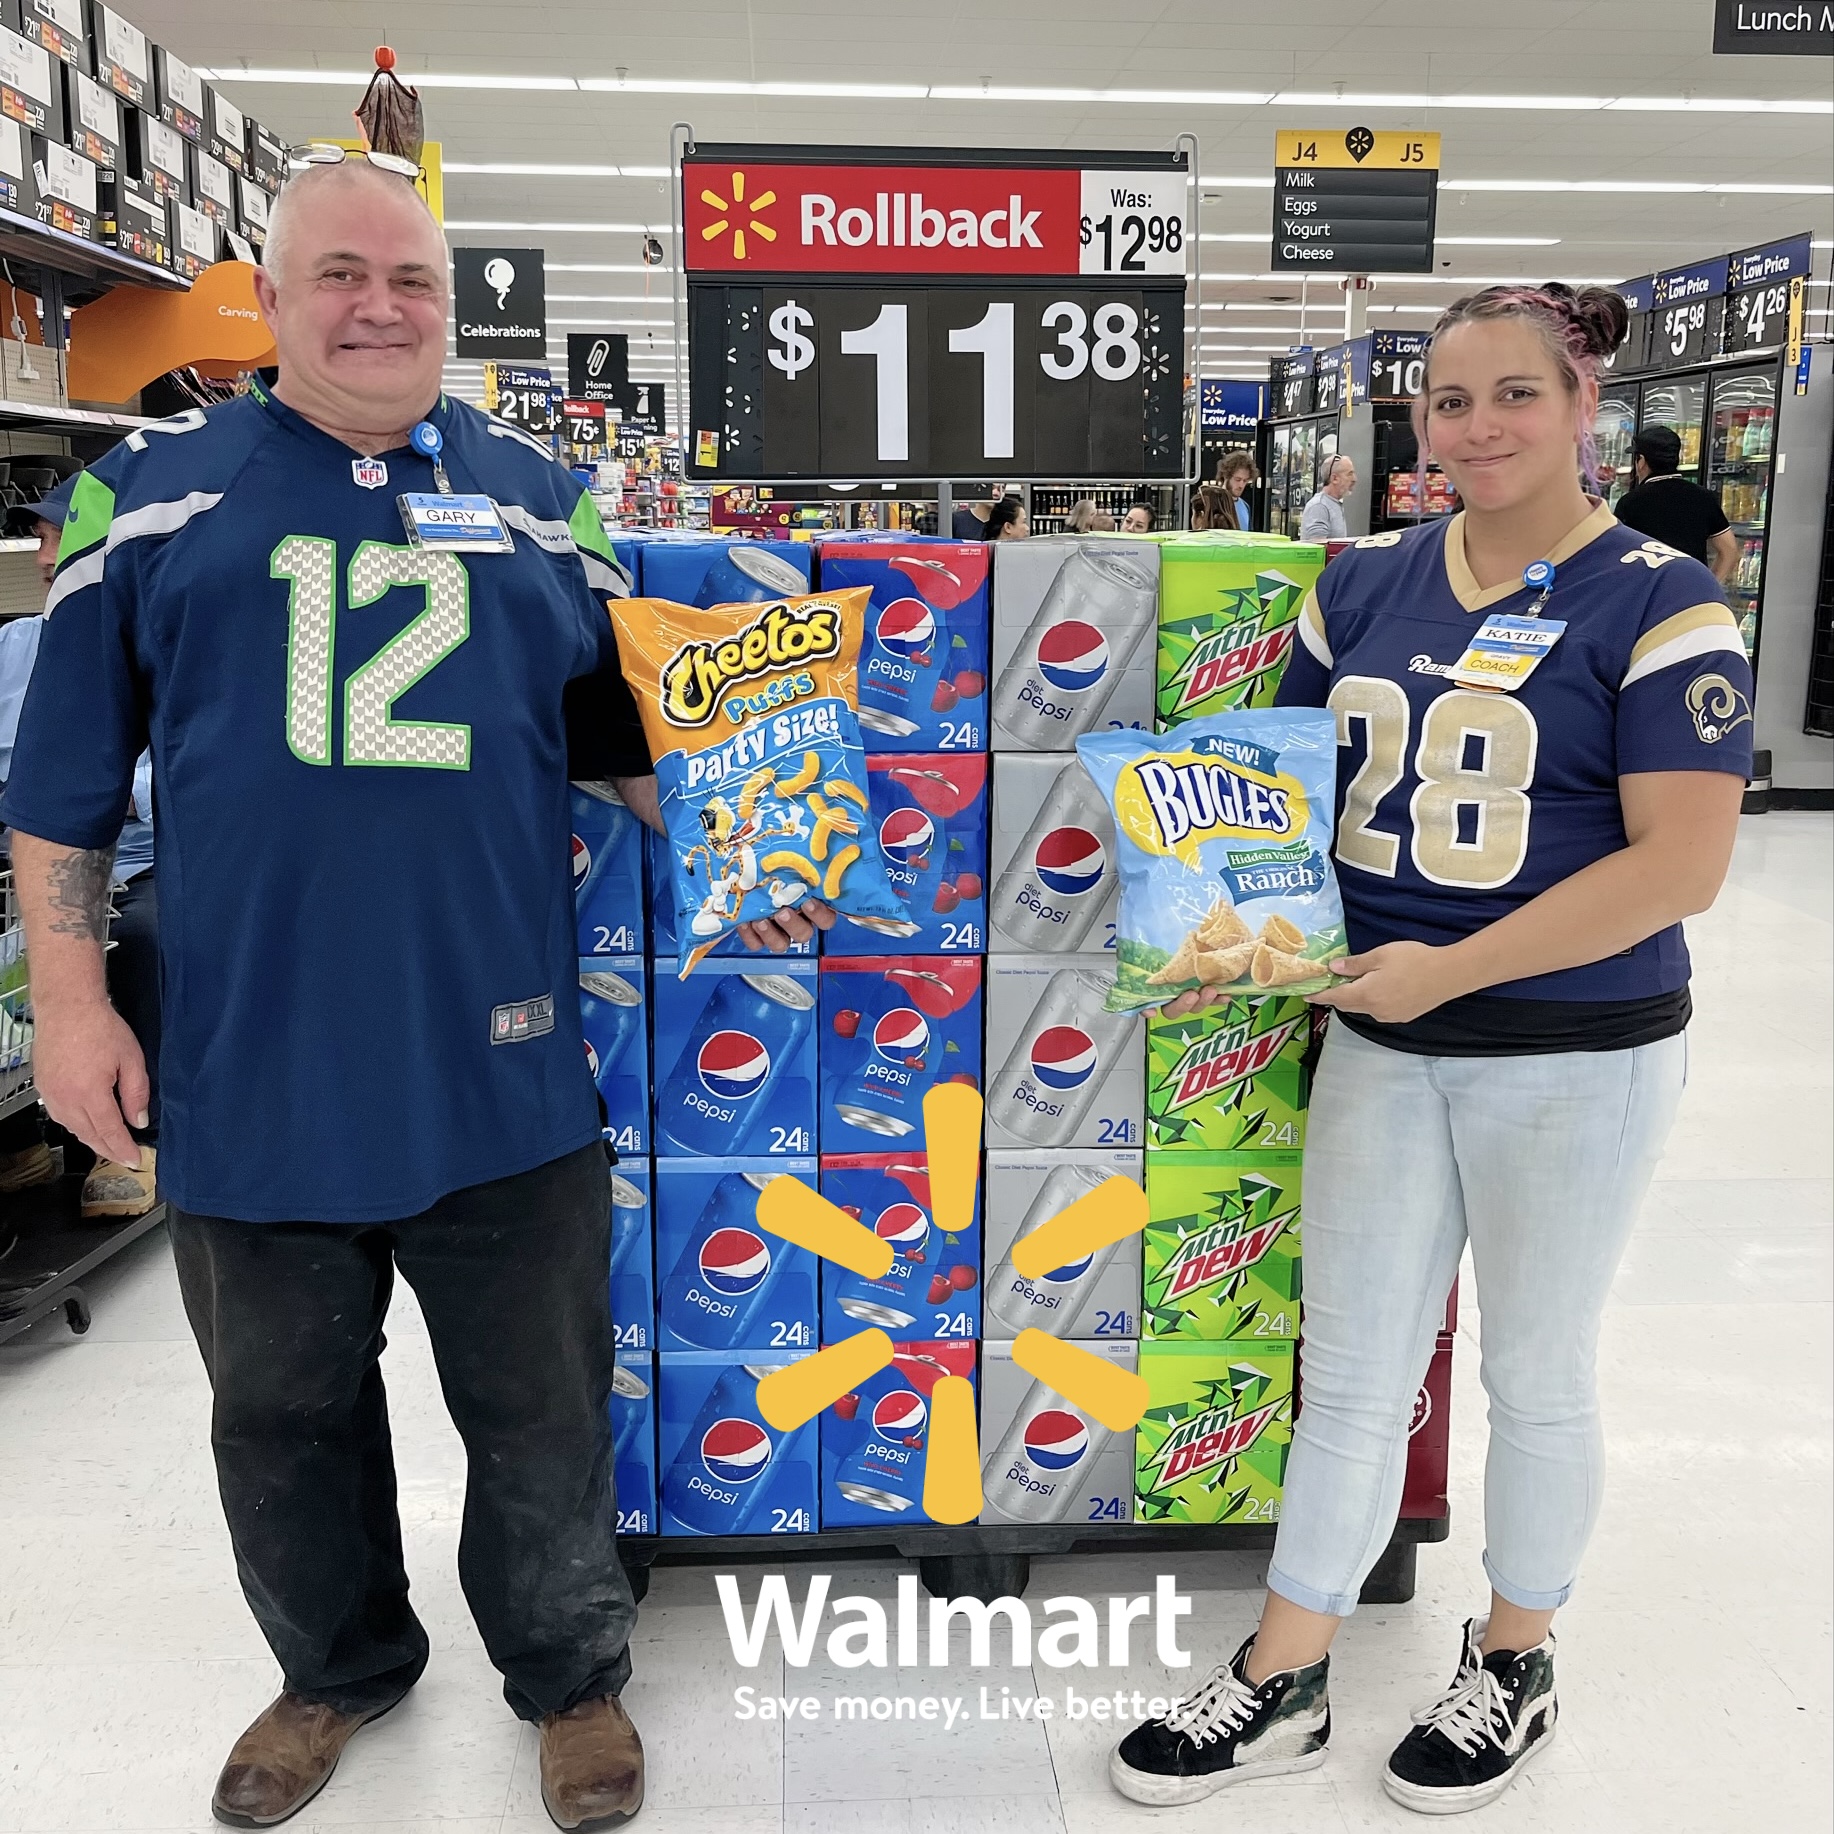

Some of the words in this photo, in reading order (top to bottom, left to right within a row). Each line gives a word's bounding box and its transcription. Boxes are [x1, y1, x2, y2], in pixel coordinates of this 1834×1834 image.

[1738, 4, 1811, 31] Lunch
[1292, 142, 1318, 161] J4
[1400, 144, 1424, 162] J5
[1286, 172, 1314, 188] Milk
[1110, 188, 1152, 208] Was:
[1284, 197, 1317, 215] Eggs
[800, 192, 1044, 248] Rollback
[1284, 221, 1330, 239] Yogurt
[1282, 245, 1334, 260] Cheese
[1743, 263, 1764, 280] Low
[1765, 256, 1790, 275] Price
[1668, 283, 1686, 300] Low
[1686, 278, 1709, 296] Price
[218, 306, 258, 321] Carving
[461, 324, 541, 338] Celebrations
[1396, 342, 1421, 353] Low
[512, 375, 529, 386] Low
[530, 377, 550, 387] Price
[586, 381, 612, 389] Home
[585, 391, 613, 400] Office
[1202, 414, 1226, 425] Low
[1228, 414, 1257, 426] Price
[360, 470, 383, 482] NFL
[426, 509, 475, 524] GARY
[1486, 629, 1547, 642] KATIE
[270, 534, 471, 772] 12
[664, 606, 835, 721] Cheetos
[1408, 654, 1451, 676] Ram
[868, 658, 917, 683] pepsi
[1471, 660, 1520, 673] COACH
[723, 672, 815, 724] Puffs
[1026, 679, 1044, 695] diet
[1017, 688, 1074, 722] pepsi
[688, 728, 766, 788] Party
[773, 704, 839, 747] Size!
[938, 722, 971, 749] 24
[1208, 738, 1260, 766] NEW!
[1326, 675, 1538, 889] 28
[1136, 760, 1289, 847] BUGLES
[1230, 852, 1272, 865] Hidden
[885, 867, 917, 886] epsi
[1235, 865, 1315, 892] Ranch
[1024, 883, 1042, 899] diet
[1015, 891, 1071, 924] pepsi
[593, 925, 627, 952] 24
[940, 923, 973, 949] 24
[864, 1063, 912, 1086] pepsi
[1020, 1079, 1037, 1094] diet
[683, 1093, 737, 1123] pepsi
[1013, 1087, 1065, 1117] pepsi
[602, 1125, 633, 1151] 24
[769, 1126, 802, 1152] 24
[1097, 1118, 1128, 1143] 24
[1260, 1121, 1292, 1146] 24
[685, 1289, 738, 1318] pepsi
[1011, 1280, 1062, 1310] pepsi
[769, 1321, 802, 1346] 24
[934, 1312, 966, 1338] 24
[1094, 1310, 1125, 1334] 24
[1253, 1312, 1285, 1336] 24
[864, 1444, 910, 1464] pepsi
[1013, 1461, 1029, 1475] diet
[688, 1477, 739, 1506] pepsi
[1006, 1468, 1056, 1496] pepsi
[771, 1508, 803, 1532] 24
[1088, 1497, 1119, 1520] 24
[1243, 1498, 1275, 1520] 24
